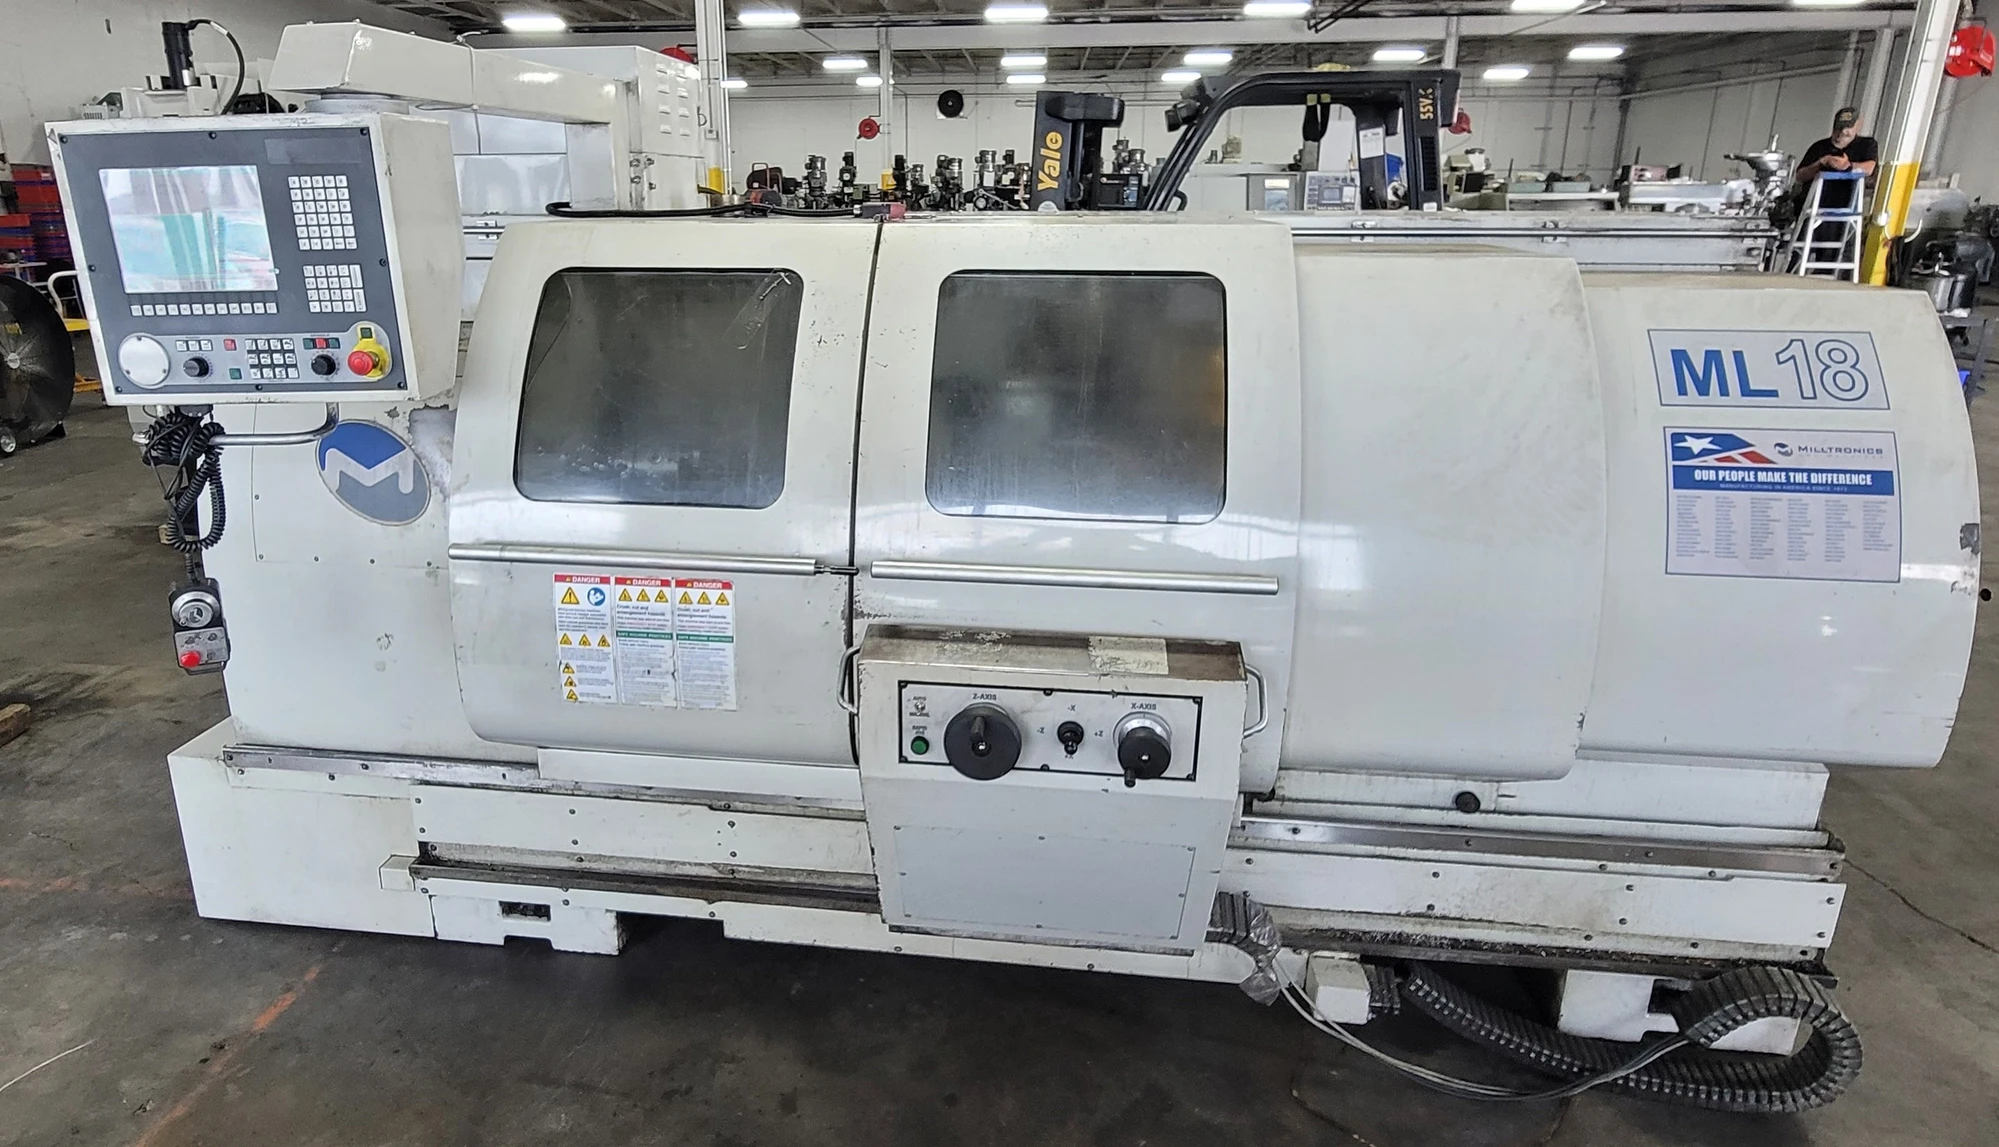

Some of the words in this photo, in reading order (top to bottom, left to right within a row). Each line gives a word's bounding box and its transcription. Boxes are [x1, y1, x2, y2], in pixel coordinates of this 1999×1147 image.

[1037, 131, 1063, 191] Yale
[1694, 469, 1717, 481] OUR
[1718, 470, 1756, 483] PEOPLE
[1757, 471, 1788, 484] MAKE
[1788, 471, 1809, 484] THE
[1810, 472, 1873, 486] DIFFERENCE
[572, 576, 600, 584] DANGER
[632, 579, 661, 587] DANGER
[693, 581, 722, 589] DANGER
[972, 693, 997, 701] Z-AXIS
[1067, 704, 1076, 712] -X
[1130, 702, 1157, 711] X-AXIS
[1094, 730, 1104, 738] +Z
